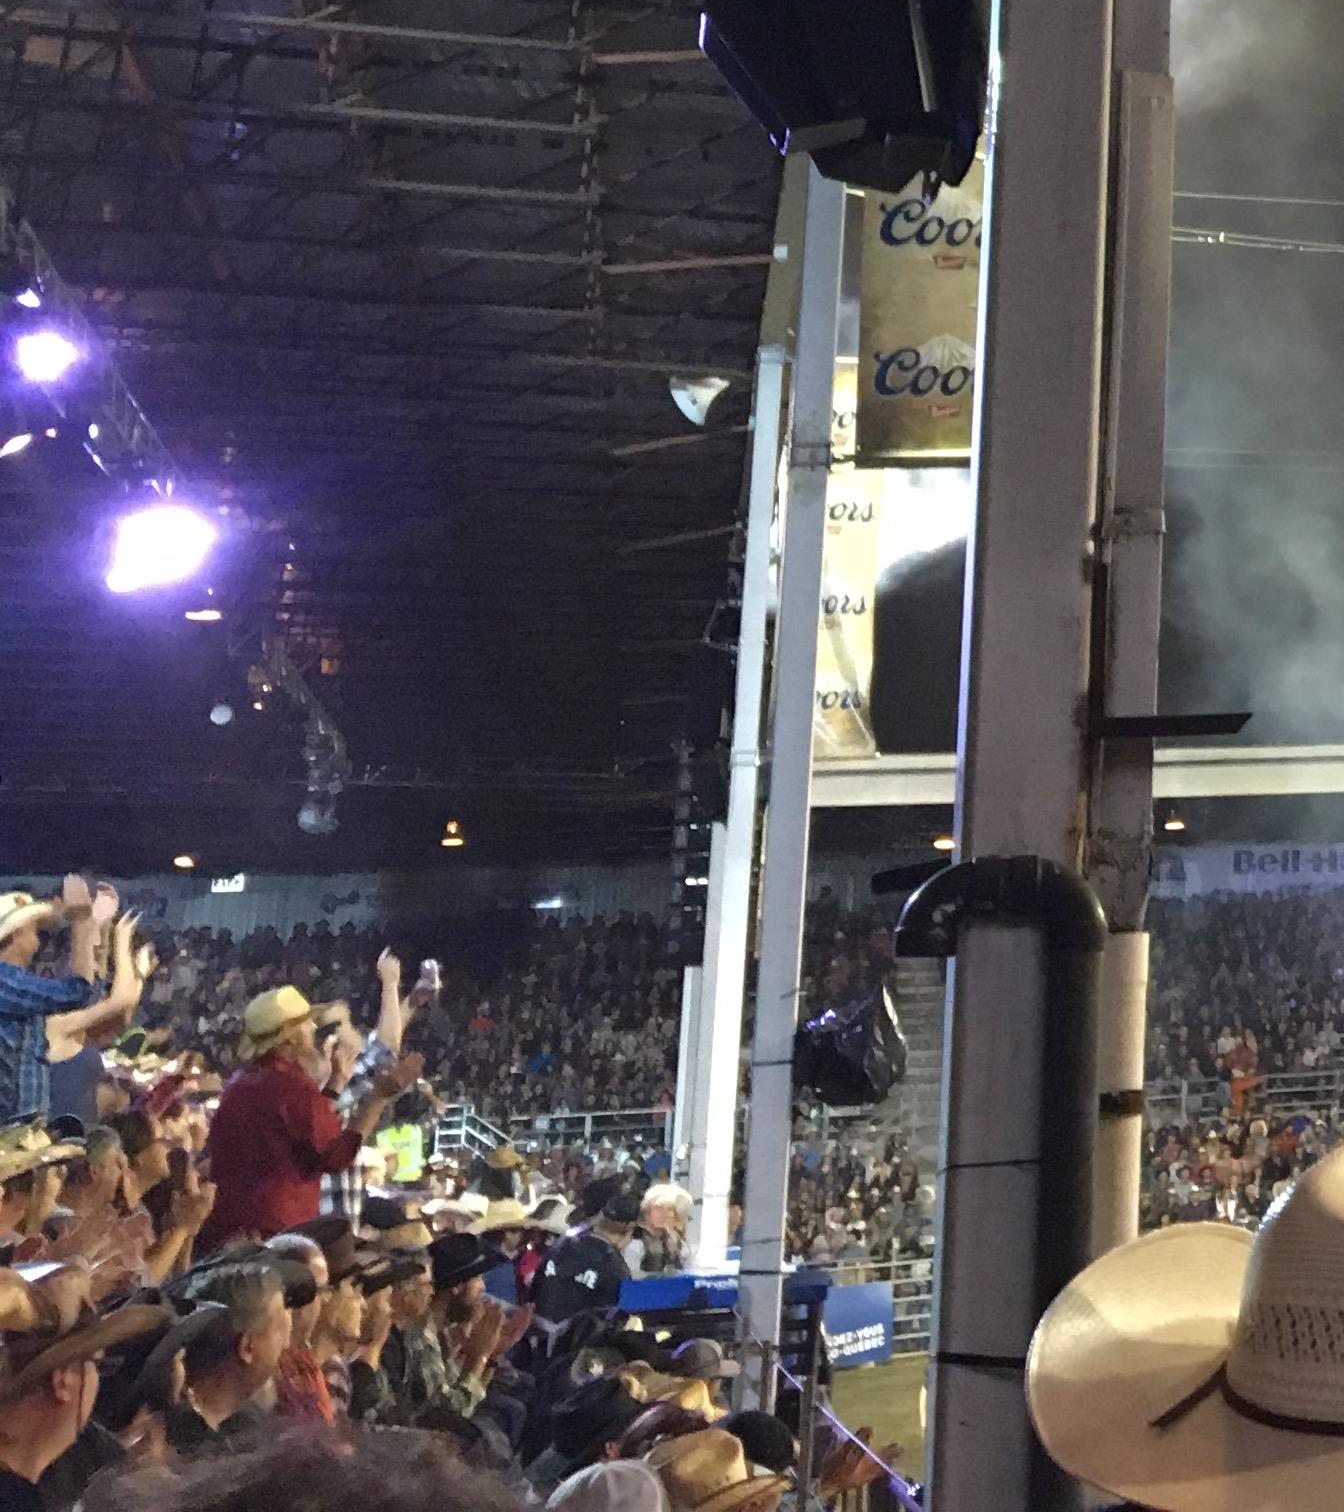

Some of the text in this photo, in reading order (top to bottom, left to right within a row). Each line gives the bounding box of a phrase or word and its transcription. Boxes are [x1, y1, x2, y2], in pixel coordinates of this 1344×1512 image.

[879, 198, 982, 246] Coo
[873, 347, 974, 397] Coo
[827, 502, 873, 522] ors
[822, 594, 867, 615] ors
[816, 691, 861, 710] ors
